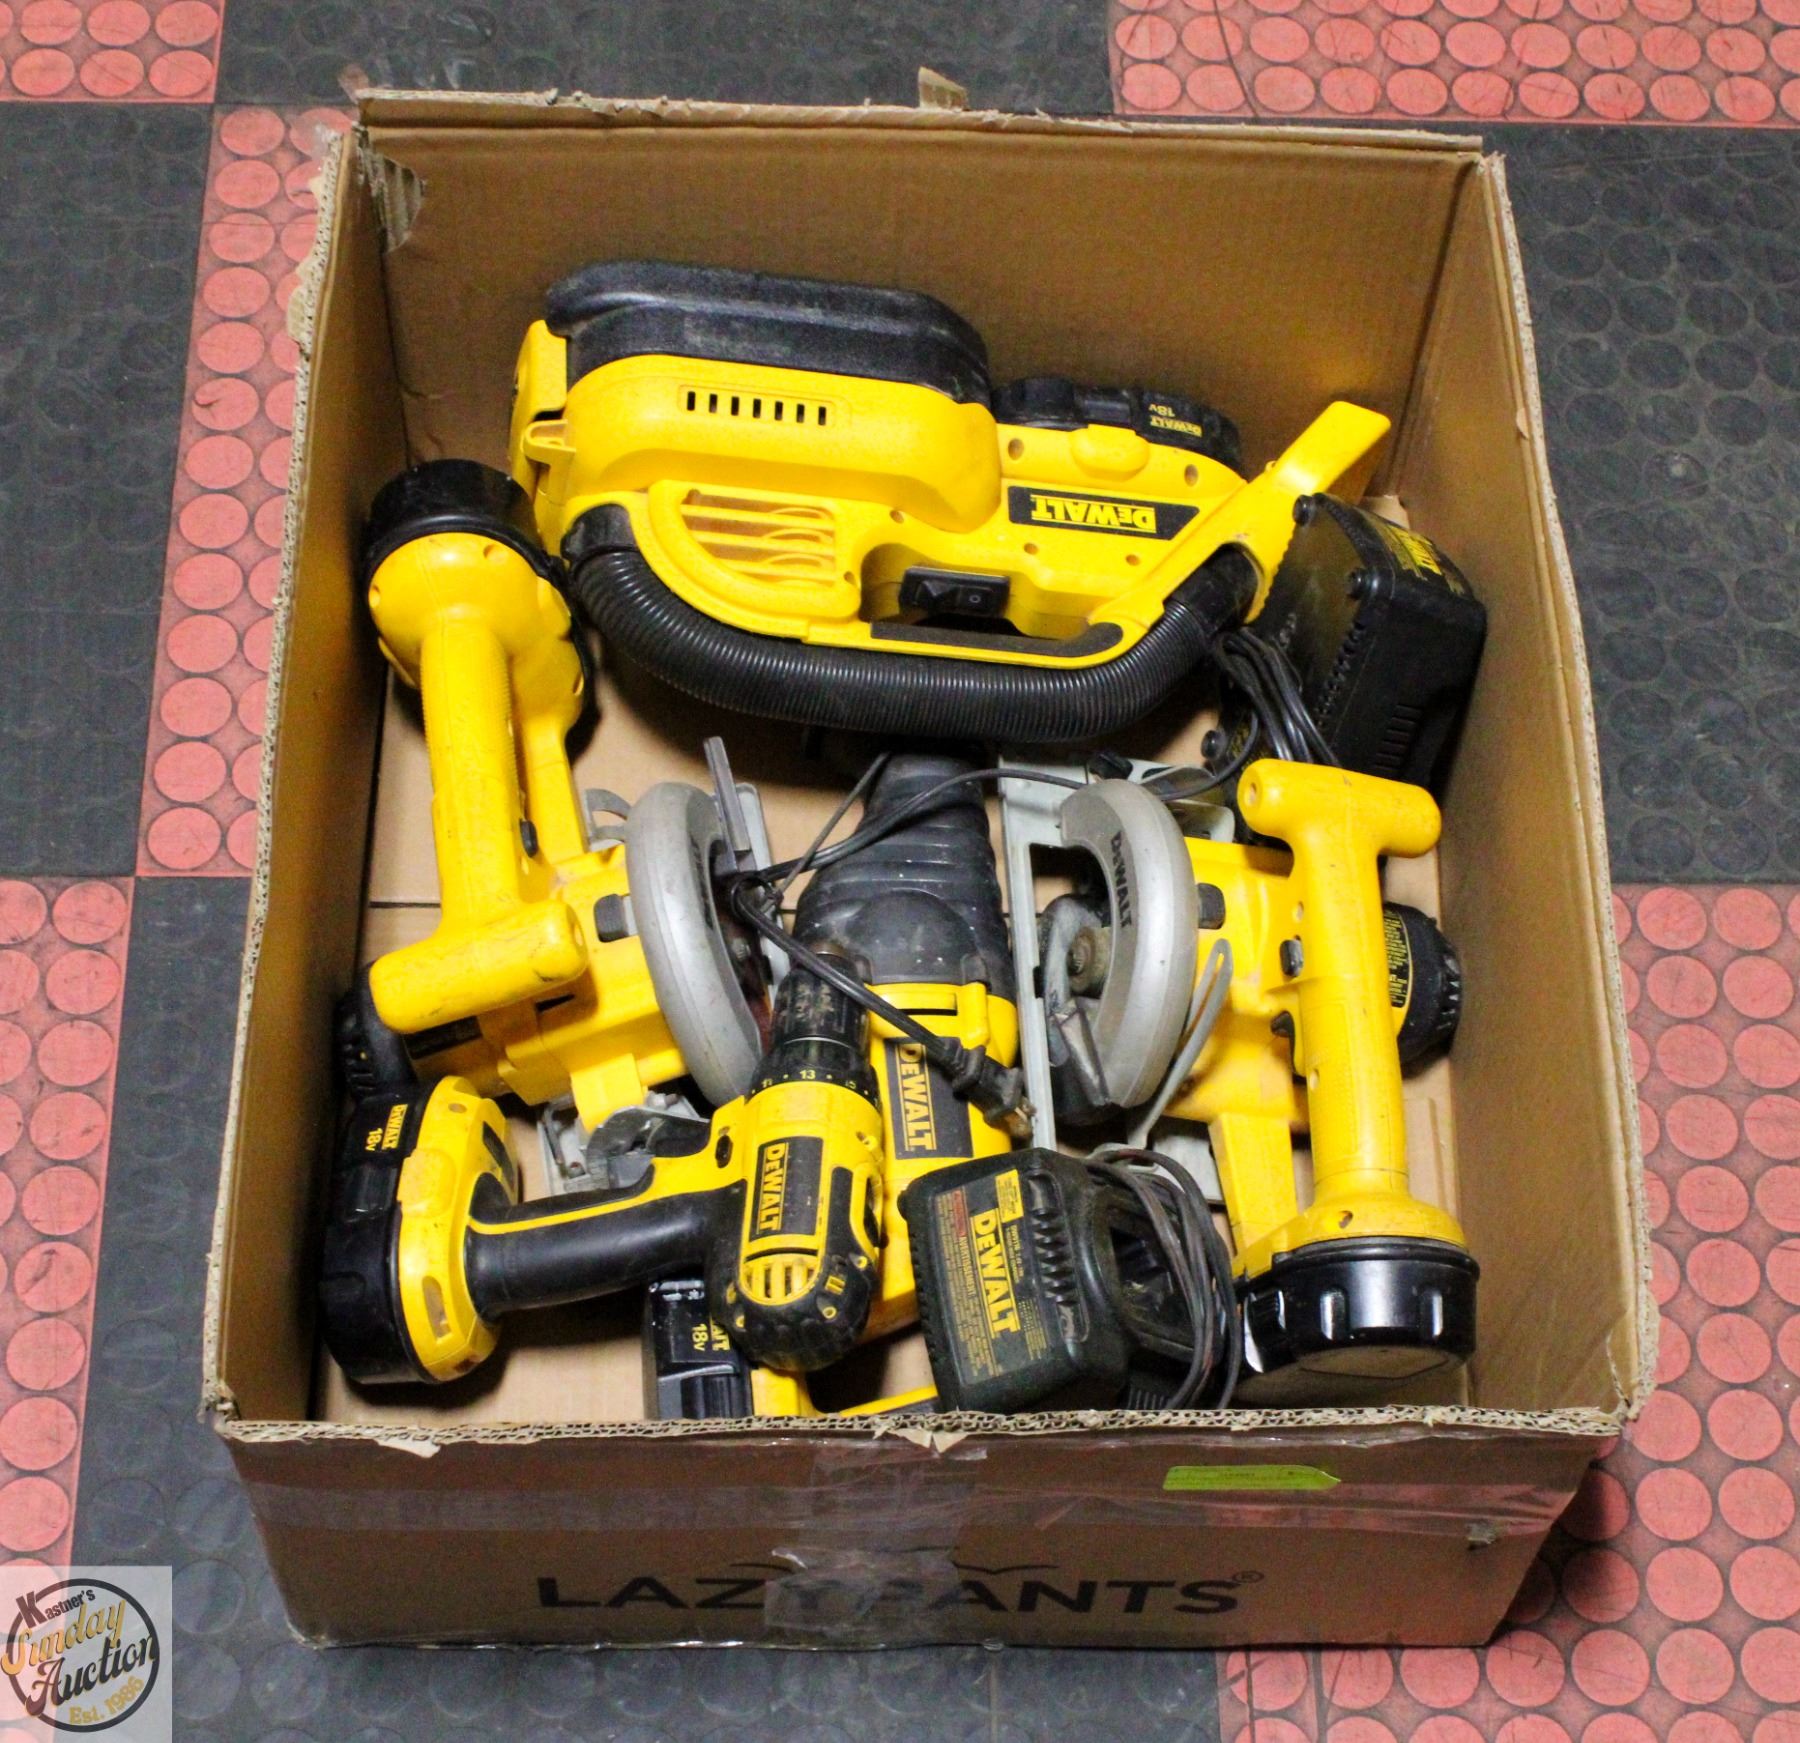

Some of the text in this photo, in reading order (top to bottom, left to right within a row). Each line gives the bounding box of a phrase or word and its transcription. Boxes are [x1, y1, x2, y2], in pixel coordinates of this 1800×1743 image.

[1150, 415, 1203, 438] DEWALT
[1031, 494, 1157, 534] DEWALT
[1110, 830, 1132, 928] DEWALT
[800, 1069, 816, 1080] 13
[896, 1042, 936, 1151] DEWALT
[382, 1104, 408, 1149] DEWALT
[757, 1142, 789, 1233] DEWALT
[970, 1208, 1021, 1339] DEWALT
